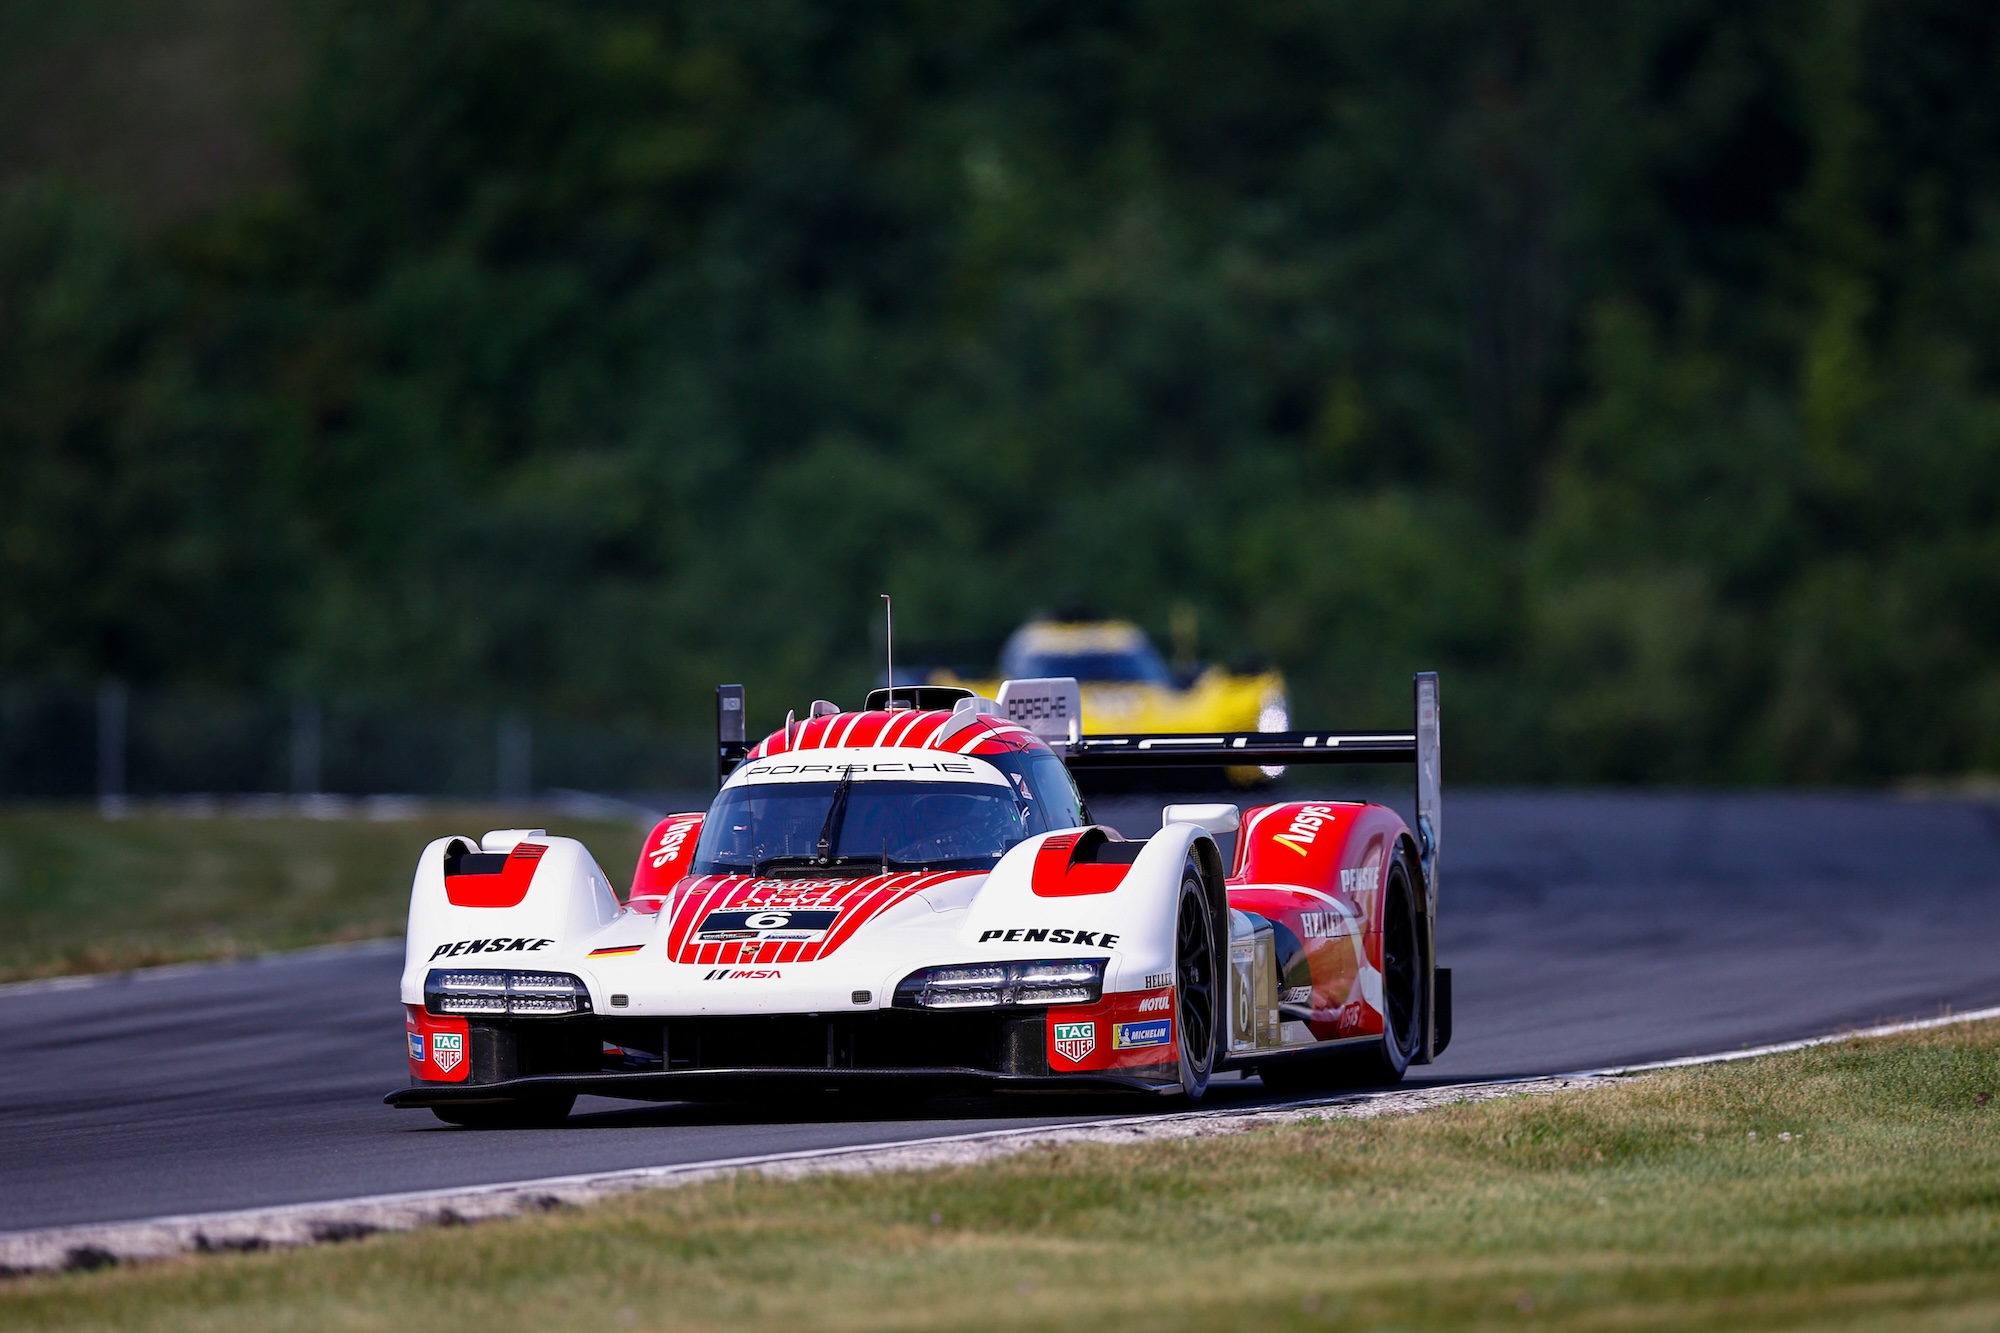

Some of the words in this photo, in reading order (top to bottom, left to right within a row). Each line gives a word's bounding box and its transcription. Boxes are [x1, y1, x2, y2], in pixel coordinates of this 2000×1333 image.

[1008, 696, 1066, 720] PORSCHE
[745, 763, 975, 777] PORSCHE
[1273, 805, 1336, 857] Ansys
[1340, 866, 1380, 893] PENSKE
[745, 911, 793, 929] 6
[1300, 911, 1343, 938] HELLER
[978, 928, 1121, 950] PENSKE
[428, 937, 556, 963] PENSKE
[729, 970, 782, 979] IMSA
[1144, 972, 1173, 989] HELLER
[1138, 996, 1170, 1012] MOTUL
[1239, 973, 1249, 1033] 6
[1057, 1025, 1092, 1038] TAG
[1131, 1028, 1167, 1040] MICHELIN
[435, 1036, 460, 1049] TAG
[1058, 1039, 1094, 1059] HEUER
[434, 1051, 461, 1069] HEUER
